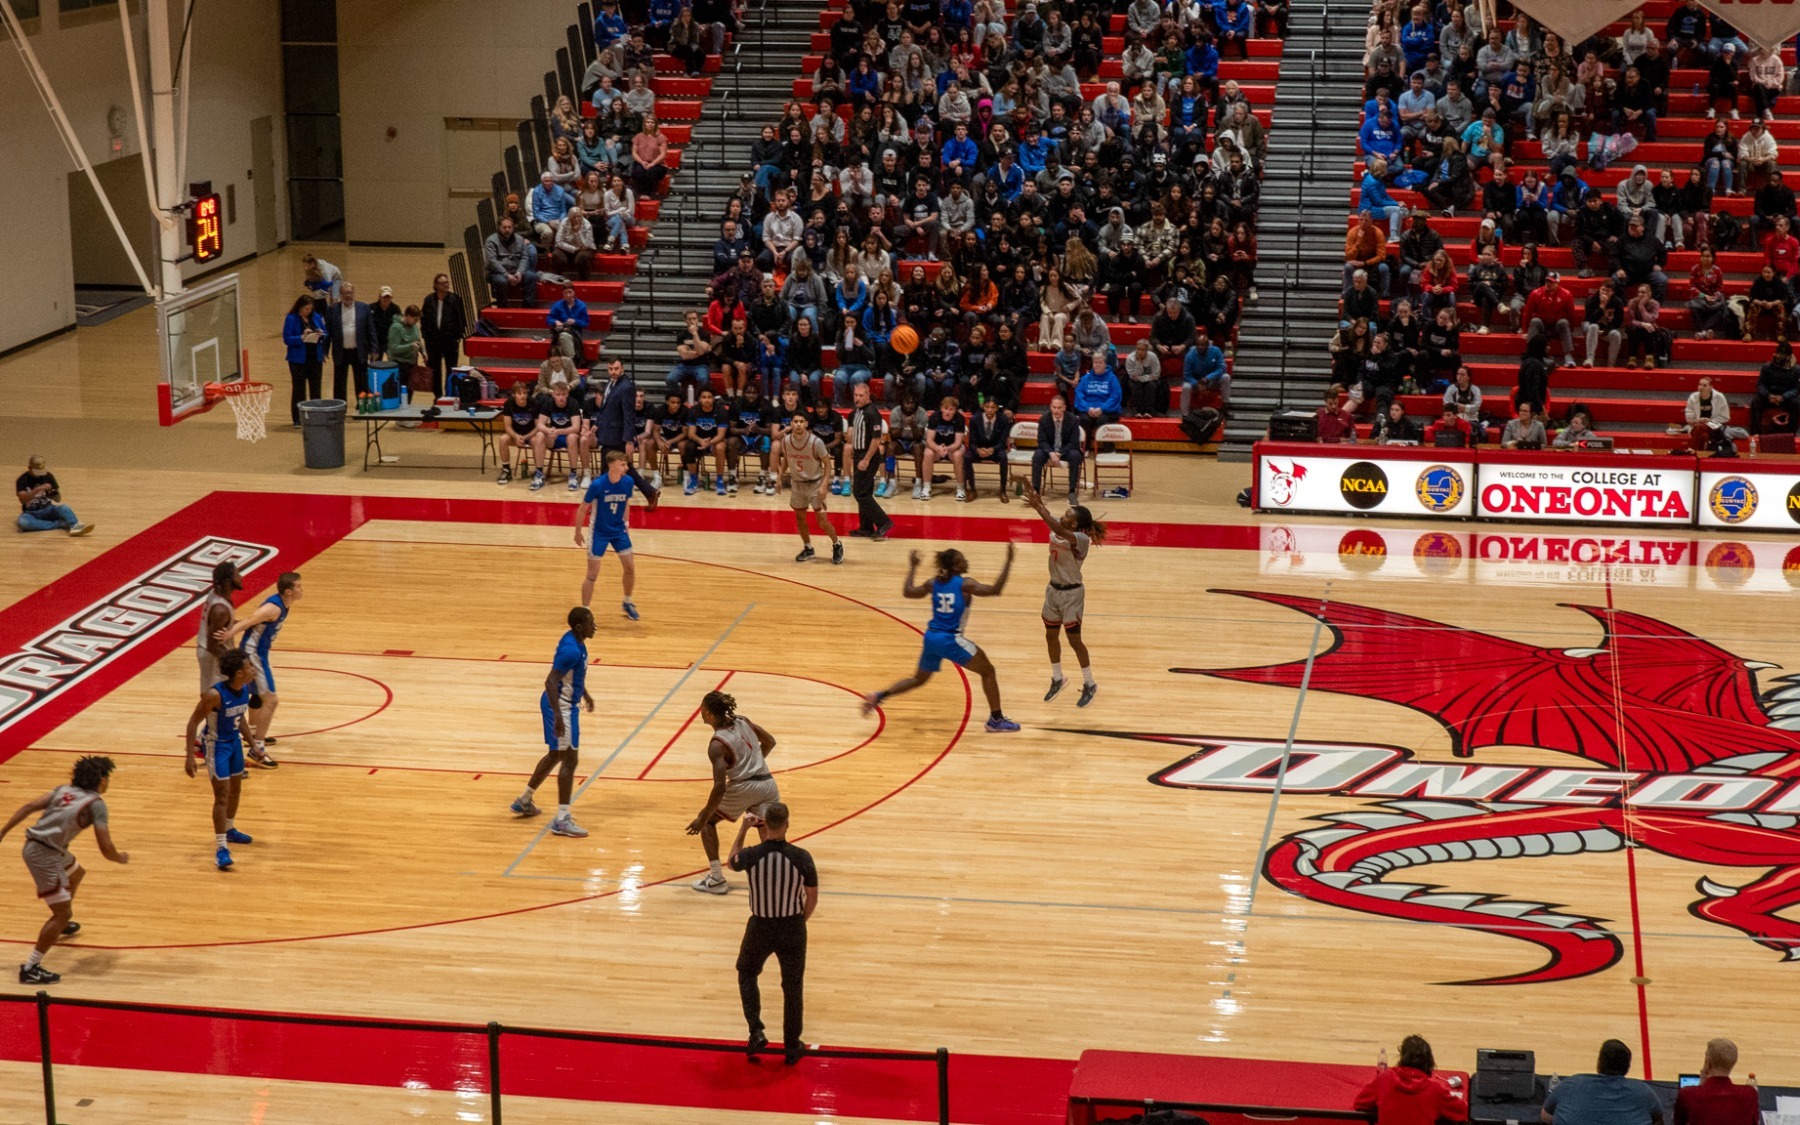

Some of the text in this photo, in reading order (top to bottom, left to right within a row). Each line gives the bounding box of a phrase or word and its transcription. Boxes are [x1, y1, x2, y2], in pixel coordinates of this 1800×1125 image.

[197, 216, 219, 257] 24
[797, 461, 804, 473] 5
[1342, 478, 1387, 493] NCAA
[1500, 472, 1535, 480] WELCOME
[1551, 473, 1564, 481] THE
[1572, 471, 1637, 486] COLLEGE
[1643, 474, 1661, 486] AT
[610, 502, 618, 515] 4
[1481, 483, 1690, 519] ONEONTA
[936, 592, 956, 613] 32
